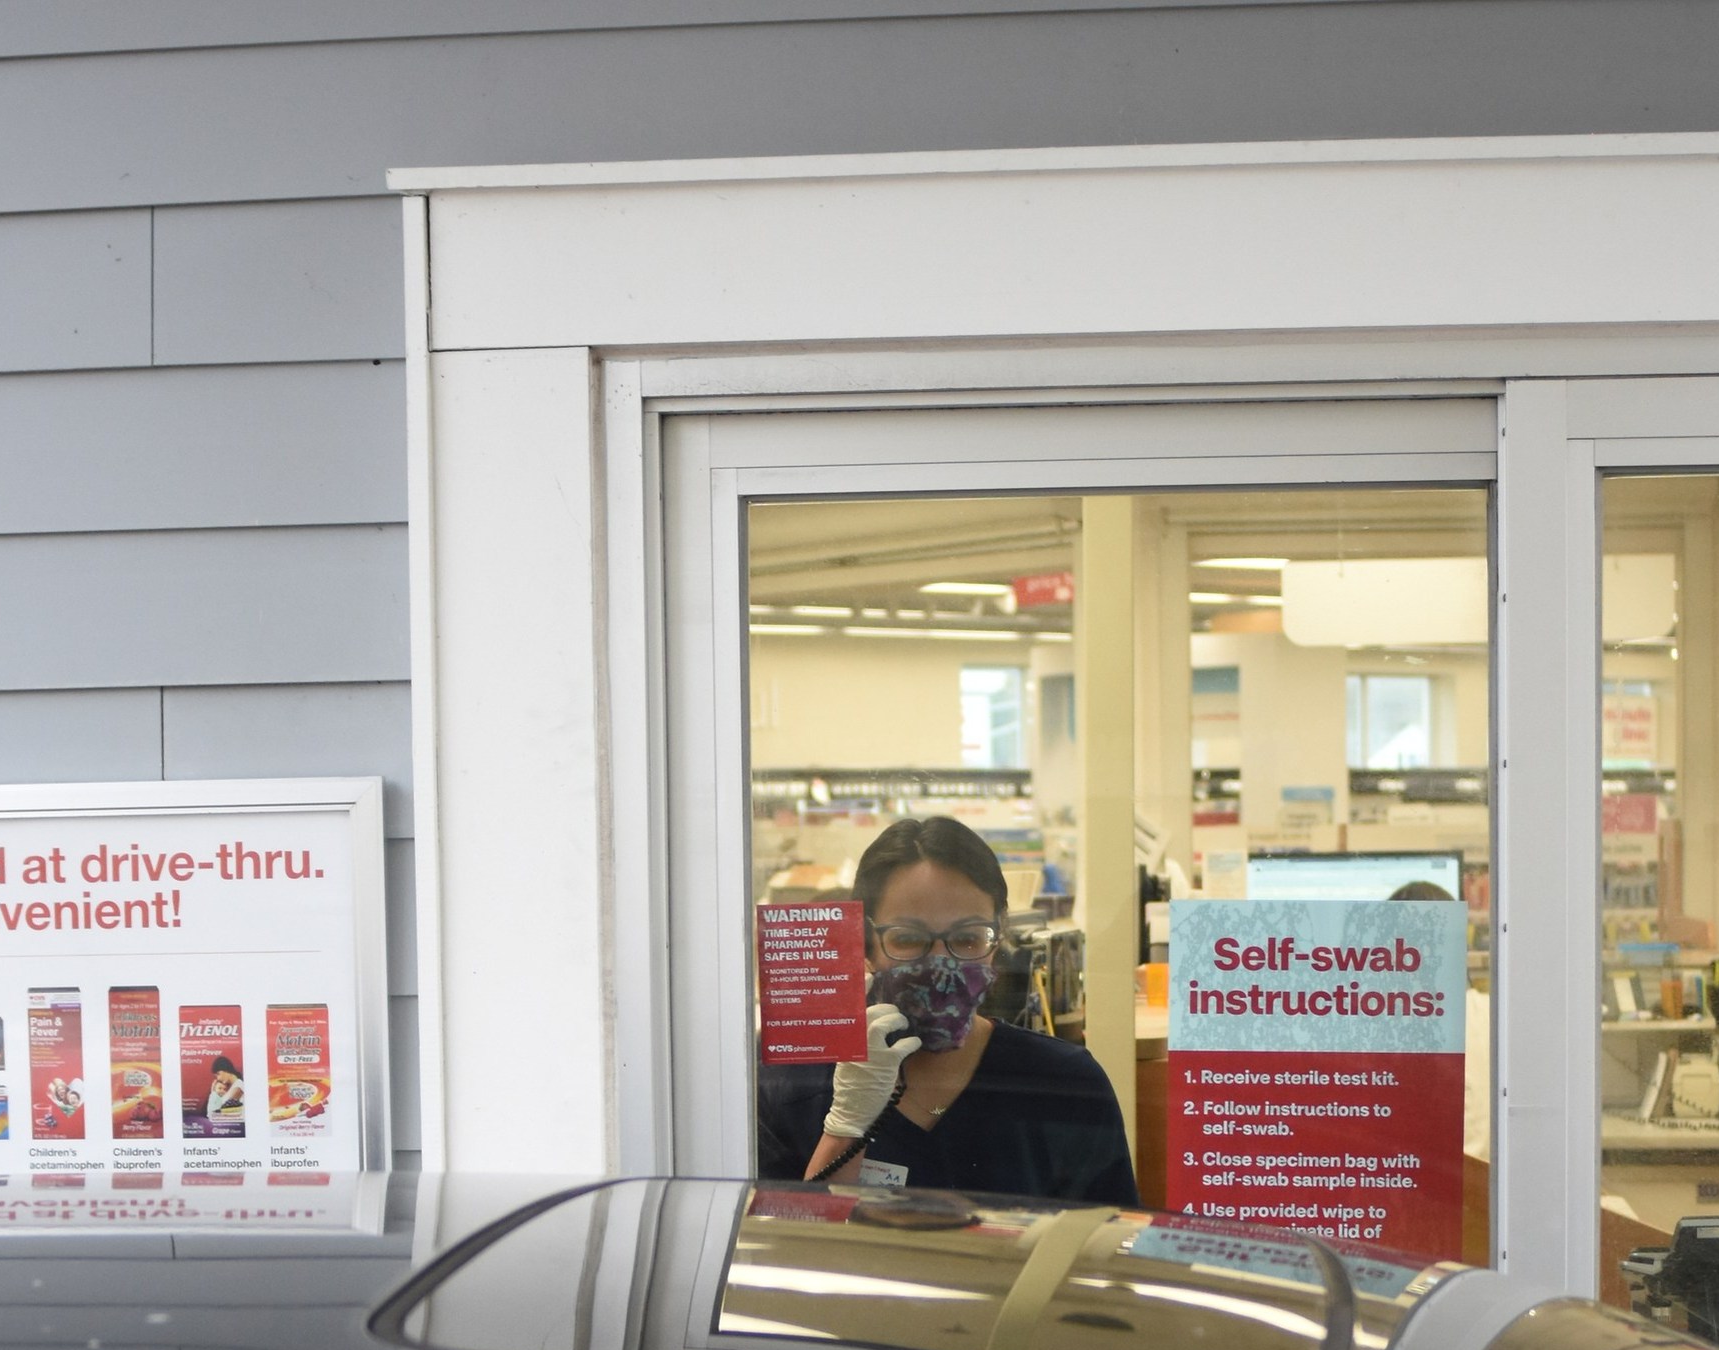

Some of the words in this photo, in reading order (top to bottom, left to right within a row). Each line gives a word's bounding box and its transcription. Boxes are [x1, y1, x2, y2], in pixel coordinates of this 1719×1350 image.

[22, 848, 66, 885] at
[81, 841, 325, 882] drive-thru.
[763, 908, 843, 922] WARNING
[764, 928, 829, 938] TIME-DELAY
[764, 939, 825, 950] PHARMACY
[764, 951, 799, 961] SAFES
[803, 951, 813, 960] IN
[816, 950, 839, 960] USE
[1213, 937, 1422, 973] Self-swab
[769, 967, 809, 975] MONITORED
[800, 974, 849, 982] SURVEILLANCE
[770, 988, 811, 996] EMERGENCY
[812, 987, 837, 995] ALARM
[1188, 980, 1446, 1017] instructions:
[30, 1016, 52, 1026] Pain
[55, 1016, 63, 1026] &
[782, 1019, 807, 1027] SAFETY
[31, 1026, 60, 1036] Fever
[180, 1022, 240, 1038] TYLENOL
[277, 1033, 321, 1046] Motrin
[776, 1044, 793, 1052] CVS
[793, 1045, 826, 1053] pharmacy
[1185, 1070, 1197, 1084] 1.
[1201, 1070, 1271, 1085] Receive
[1274, 1070, 1330, 1086] sterile
[1333, 1071, 1368, 1086] test
[1371, 1071, 1400, 1086] kit.
[1183, 1101, 1199, 1115] 2.
[1203, 1101, 1261, 1116] Follow
[1265, 1102, 1370, 1117] instructions
[1373, 1103, 1392, 1117] to
[1202, 1121, 1295, 1136] self-swab.
[29, 1148, 77, 1157] Children's
[113, 1147, 163, 1157] Children's
[183, 1146, 221, 1156] Infants'
[270, 1146, 308, 1155] Infants'
[29, 1161, 105, 1172] acetaminophen
[113, 1160, 161, 1171] ibuprofen
[183, 1159, 262, 1170] acetaminophen
[270, 1158, 319, 1169] ibuprofen
[1183, 1152, 1198, 1167] 3.
[1203, 1152, 1252, 1167] Close
[1256, 1153, 1341, 1170] specimen
[1344, 1153, 1378, 1171] bag
[1382, 1154, 1421, 1169] with
[1202, 1172, 1289, 1187] self-swab
[1292, 1173, 1357, 1190] sample
[1360, 1173, 1418, 1188] inside.
[1183, 1203, 1198, 1216] 4.
[1203, 1203, 1235, 1217] Use
[1239, 1203, 1318, 1220] provided
[1322, 1204, 1365, 1220] wipe
[1368, 1206, 1387, 1219] to
[1338, 1223, 1360, 1239] lid
[1363, 1224, 1383, 1239] of
